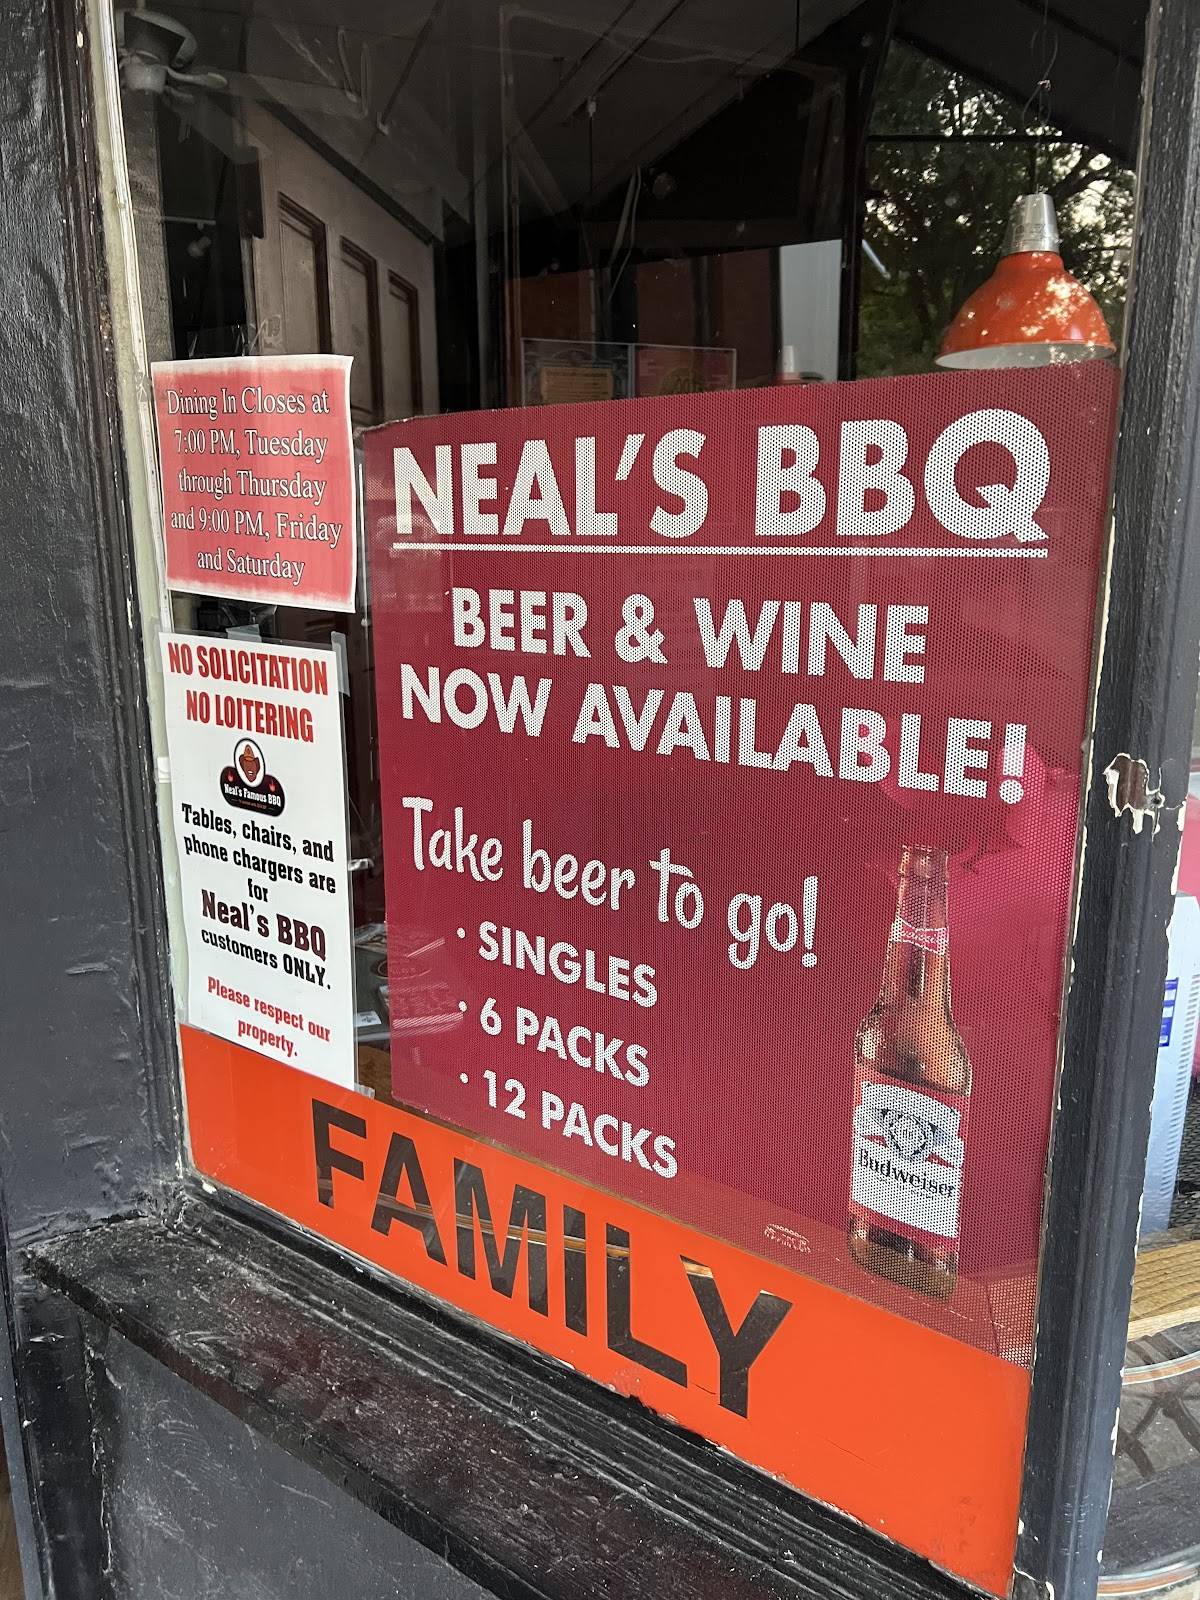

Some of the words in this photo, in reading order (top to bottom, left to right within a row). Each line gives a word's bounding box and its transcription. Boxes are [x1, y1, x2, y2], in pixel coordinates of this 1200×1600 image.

[167, 390, 218, 421] Dining
[221, 388, 237, 414] In
[241, 387, 306, 414] Closes
[311, 390, 330, 414] at
[174, 429, 206, 455] 7:00
[210, 430, 241, 460] PM,
[244, 429, 328, 464] Tuesday
[394, 428, 709, 539] NEAL'S
[755, 408, 1050, 543] BBQ
[178, 468, 232, 500] through
[236, 470, 326, 506] Thursday
[171, 507, 195, 531] and
[199, 508, 230, 534] 9:00
[234, 510, 271, 542] PM,
[275, 512, 343, 549] Friday
[197, 547, 223, 572] and
[226, 549, 305, 586] Saturday
[452, 587, 591, 659] BEER
[614, 593, 668, 665] &
[693, 597, 929, 684] WINE
[167, 642, 194, 676] NO
[196, 645, 328, 696] SOLICITATION
[186, 689, 211, 724] NO
[215, 694, 314, 743] LOITERING
[400, 663, 552, 737] NOW
[571, 683, 1028, 805] AVAILABLE!
[223, 783, 243, 797] Neal's
[243, 787, 267, 803] Famous
[267, 793, 282, 808] BBQ
[182, 803, 237, 839] Tables,
[242, 820, 297, 854] chairs,
[302, 838, 334, 862] and
[183, 833, 228, 862] phone
[233, 848, 303, 884] chargers
[309, 871, 336, 894] are
[247, 878, 268, 902] for
[402, 796, 504, 882] Take
[522, 818, 636, 911] beer
[649, 847, 705, 930] to
[727, 874, 819, 970] go!
[201, 889, 270, 938] Neal's
[276, 914, 327, 962] BBQ
[201, 928, 278, 970] customers
[283, 953, 331, 990] ONLY.
[478, 920, 658, 1008] SINGLES
[207, 976, 250, 1008] Please
[254, 997, 304, 1031] respect
[308, 1020, 331, 1042] our
[238, 1019, 298, 1057] property.
[479, 997, 503, 1036] 6
[516, 1006, 651, 1088] PACKS
[482, 1069, 527, 1120] 12
[541, 1090, 679, 1179] PACKS
[859, 1148, 956, 1198] Budweiser
[311, 1098, 793, 1419] FAMILY
